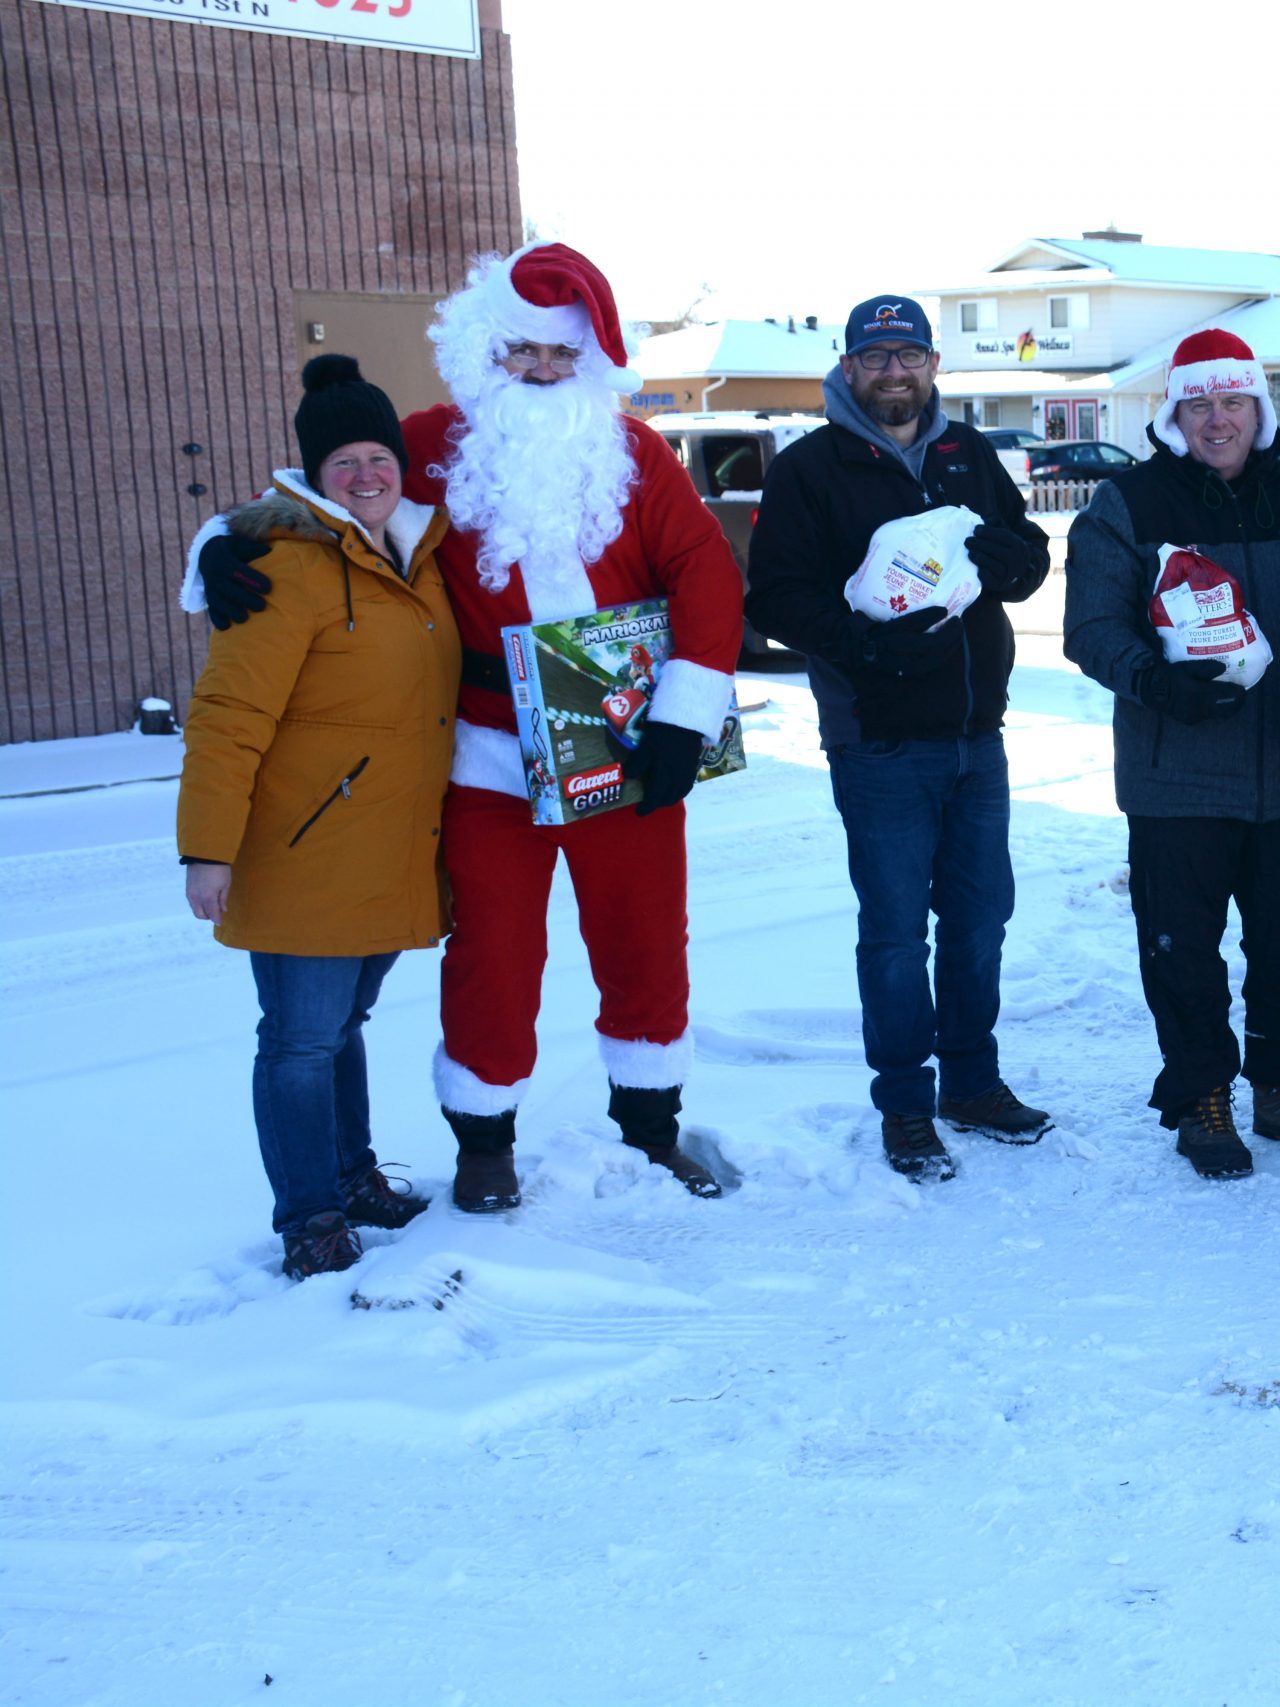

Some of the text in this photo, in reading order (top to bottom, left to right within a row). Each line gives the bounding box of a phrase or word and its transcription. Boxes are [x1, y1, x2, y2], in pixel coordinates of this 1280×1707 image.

[252, 4, 269, 17] N
[1183, 382, 1204, 396] Merry
[1207, 373, 1243, 391] Christmas
[883, 573, 906, 590] JEUNE
[908, 586, 929, 600] DINDE
[887, 566, 909, 583] YOUNG
[909, 578, 934, 596] TURKEY
[1188, 625, 1236, 638] YOUNG TURKEY
[1189, 632, 1238, 644] JEUNE DINDON
[568, 765, 621, 794] Carrera
[573, 783, 622, 811] GO!!!
